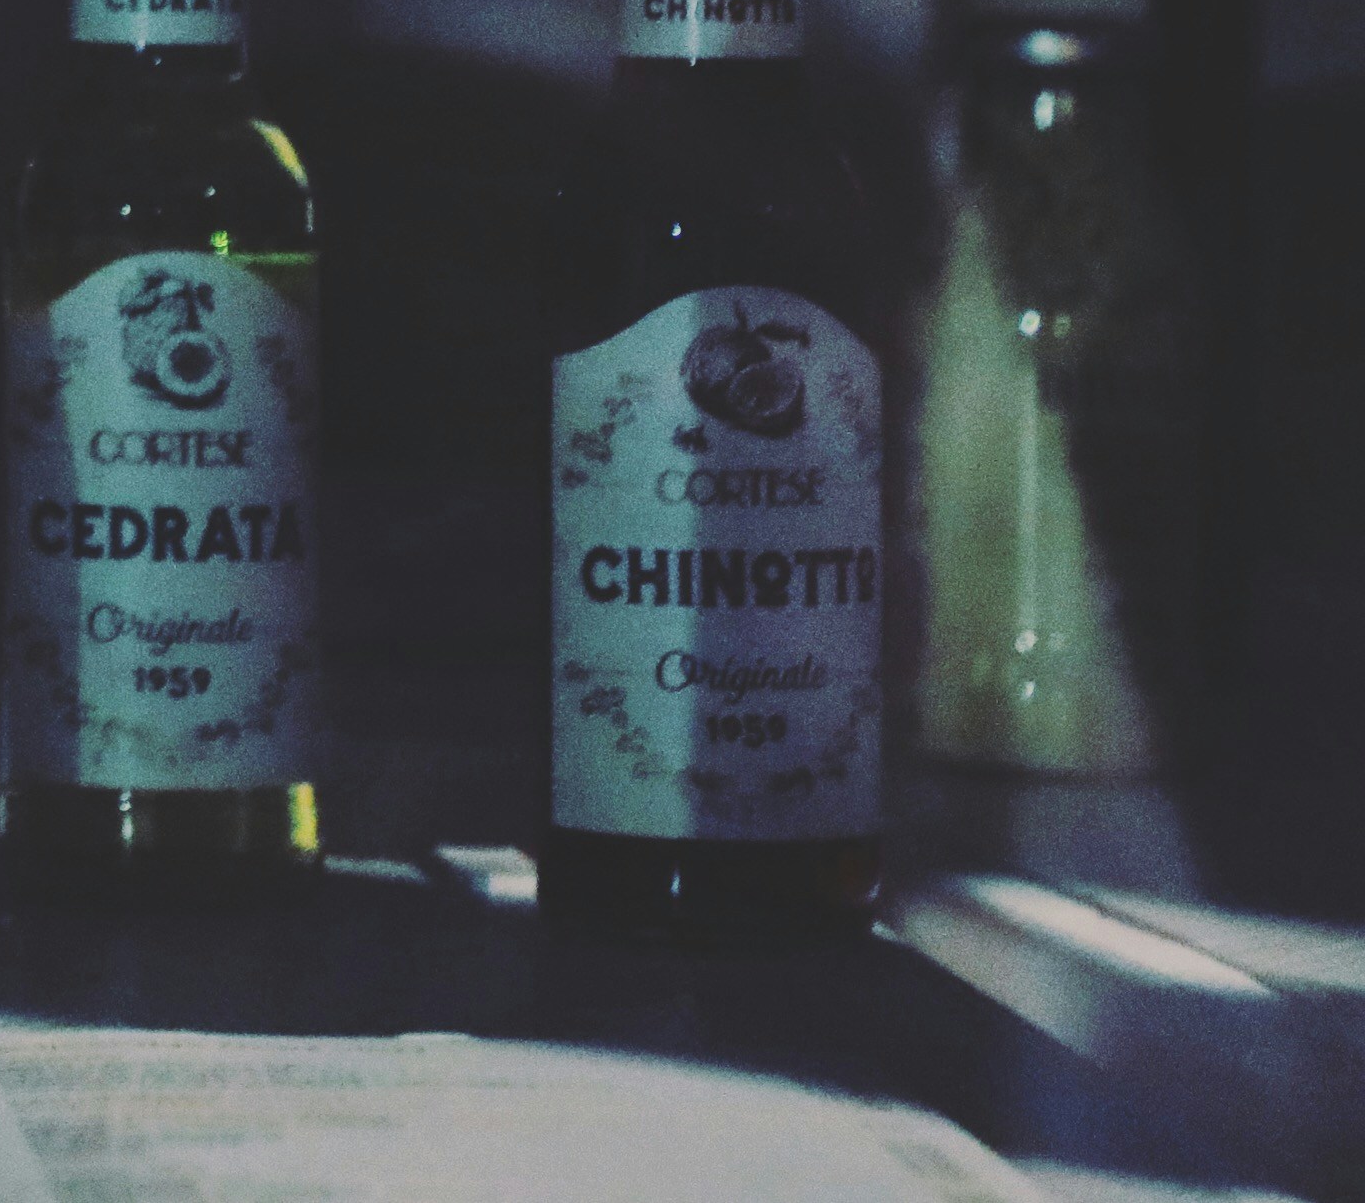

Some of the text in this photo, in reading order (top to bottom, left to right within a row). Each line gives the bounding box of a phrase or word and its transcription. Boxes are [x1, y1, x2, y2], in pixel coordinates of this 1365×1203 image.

[88, 428, 253, 469] CORTESE
[657, 467, 826, 508] CORTESE
[29, 499, 304, 563] CEDRATA
[86, 602, 254, 657] Originale
[132, 664, 213, 700] 1959
[656, 649, 830, 707] Originale
[706, 712, 789, 750] 1959
